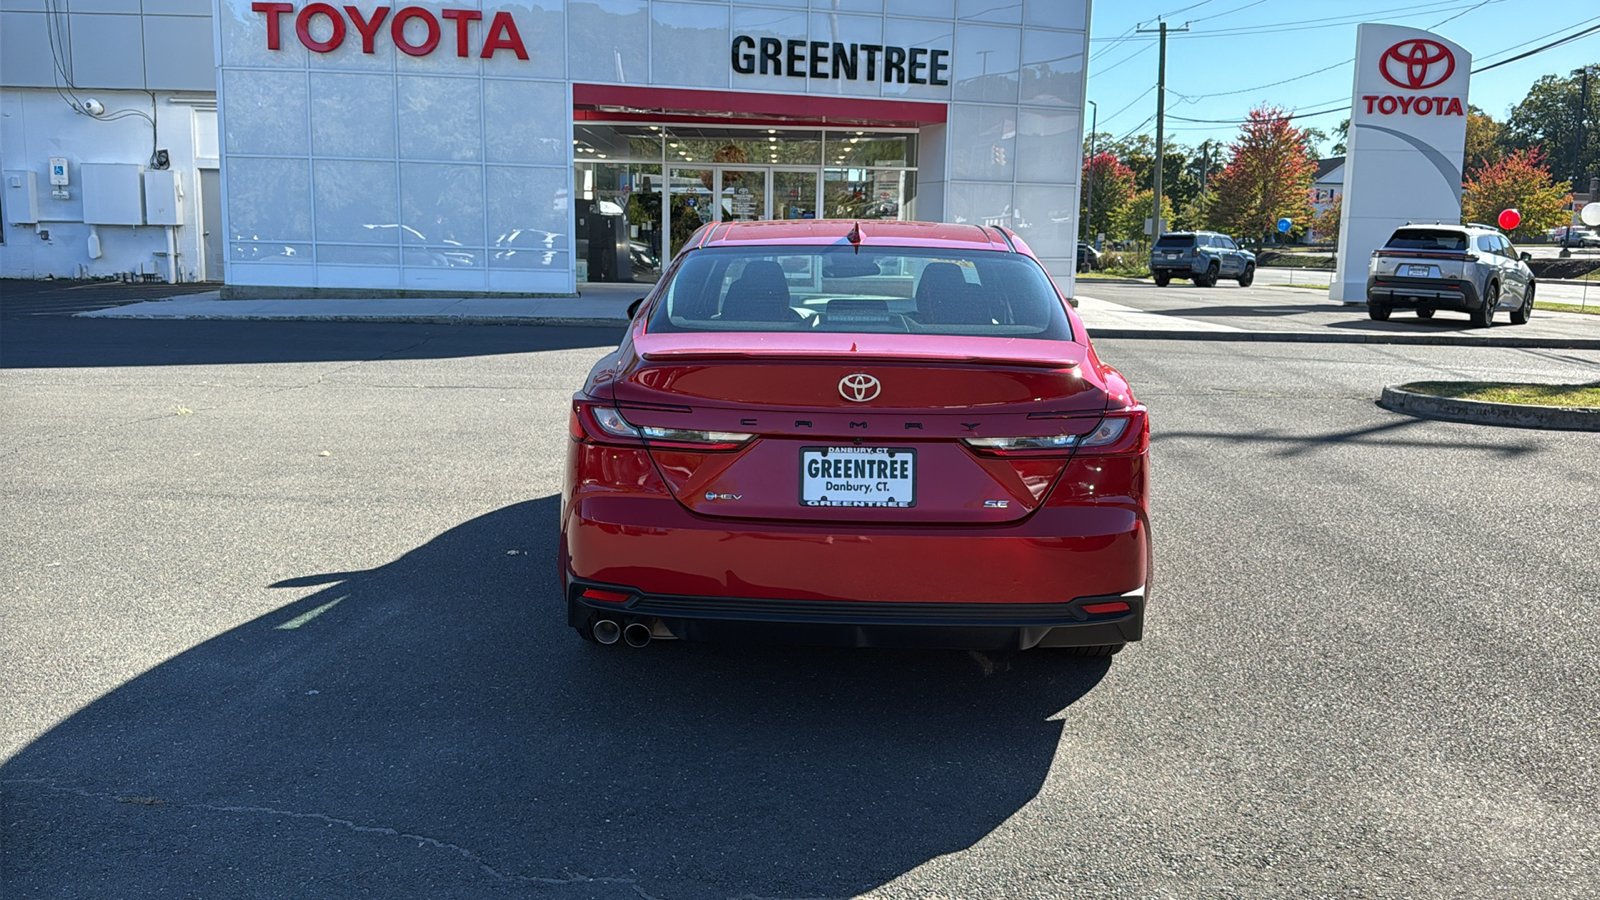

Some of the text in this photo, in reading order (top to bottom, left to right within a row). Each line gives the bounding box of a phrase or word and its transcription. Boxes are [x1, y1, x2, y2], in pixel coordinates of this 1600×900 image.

[252, 2, 530, 60] TOYOTA
[731, 35, 949, 86] GREENTREE
[1362, 95, 1464, 116] TOYOTA
[740, 418, 981, 430] CAMRY
[807, 459, 909, 479] GREENTREE
[825, 481, 890, 494] Danbury, CT.
[983, 500, 1009, 508] SE
